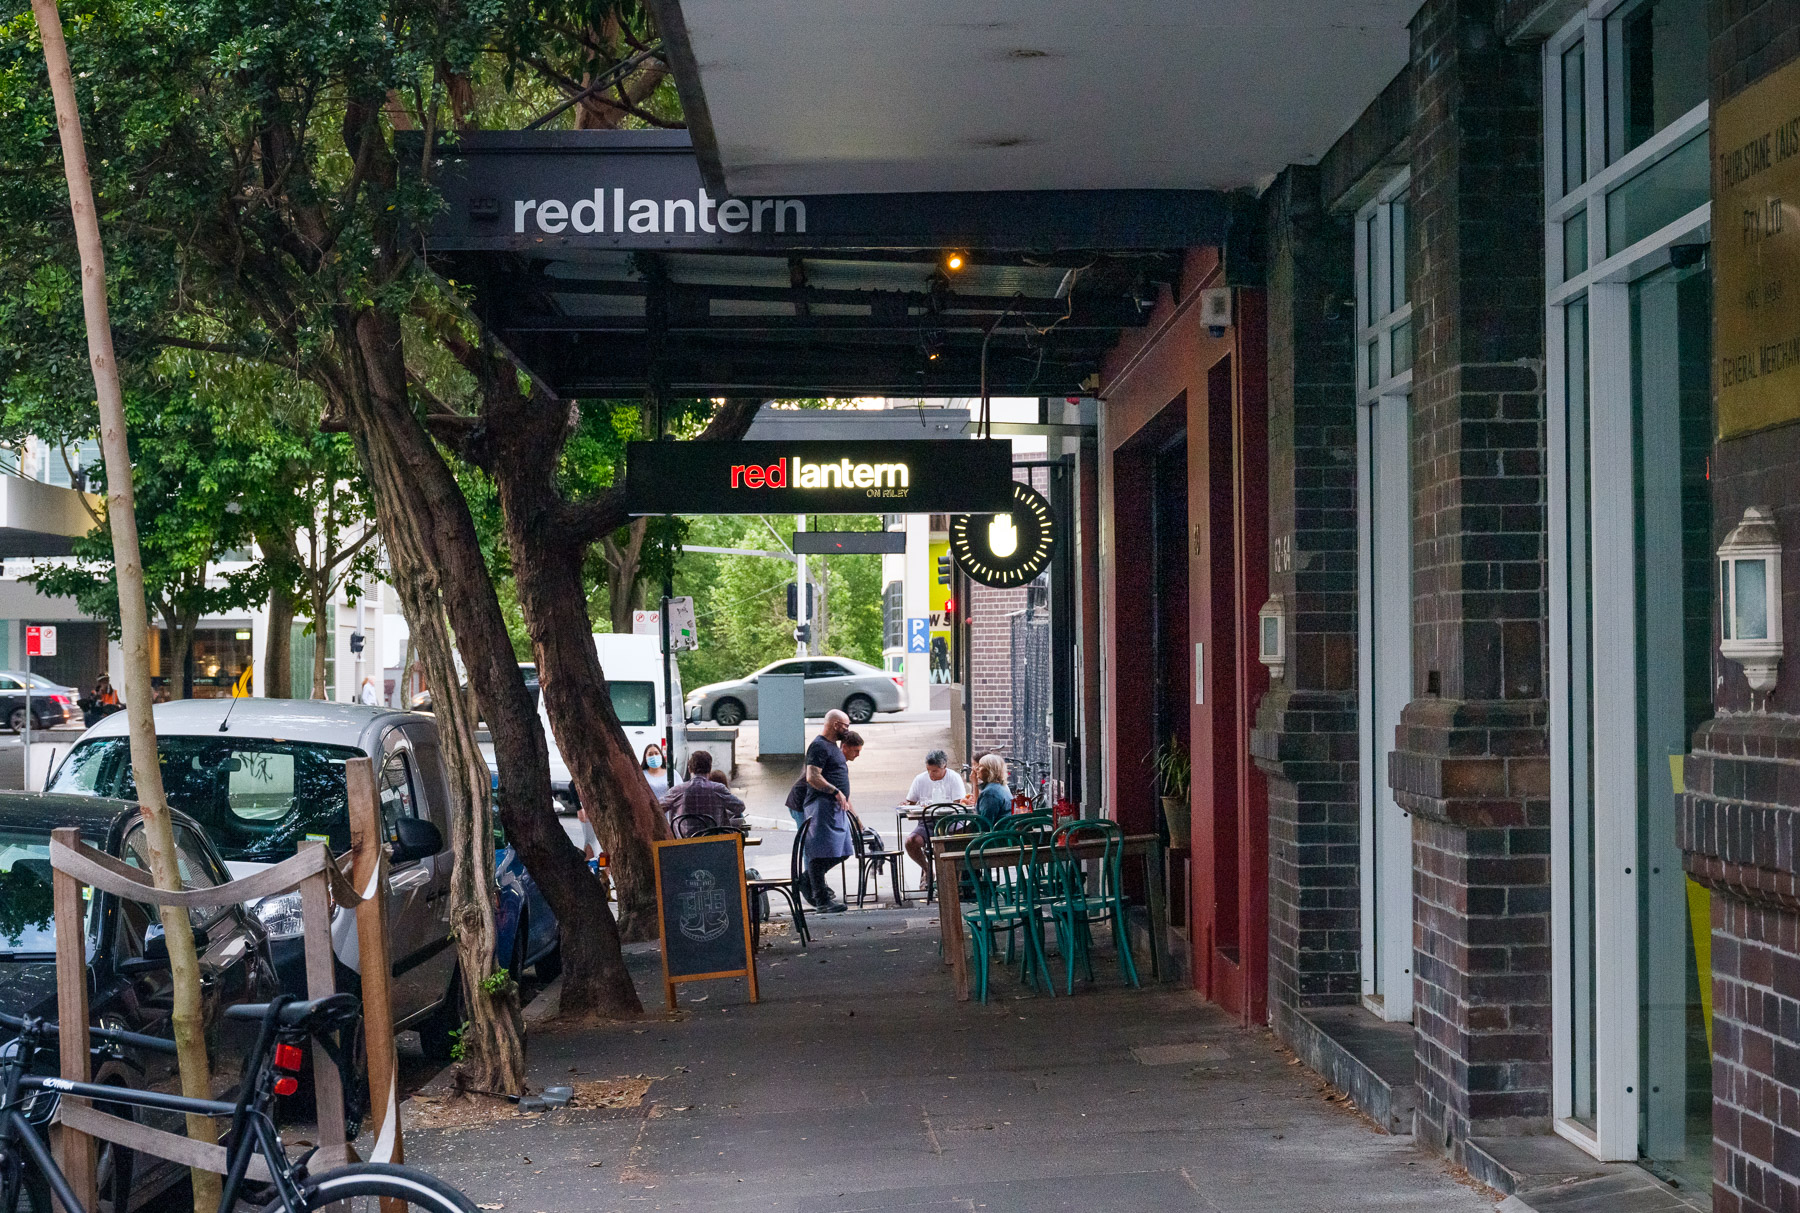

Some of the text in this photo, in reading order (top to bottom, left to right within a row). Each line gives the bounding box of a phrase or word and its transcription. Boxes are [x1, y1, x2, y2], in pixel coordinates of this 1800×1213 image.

[1720, 114, 1800, 192] THURLSTANE (AUS
[1722, 352, 1758, 388] GENERAL
[731, 456, 909, 488] red lantern
[866, 488, 909, 498] ON RILEY
[912, 619, 925, 635] P
